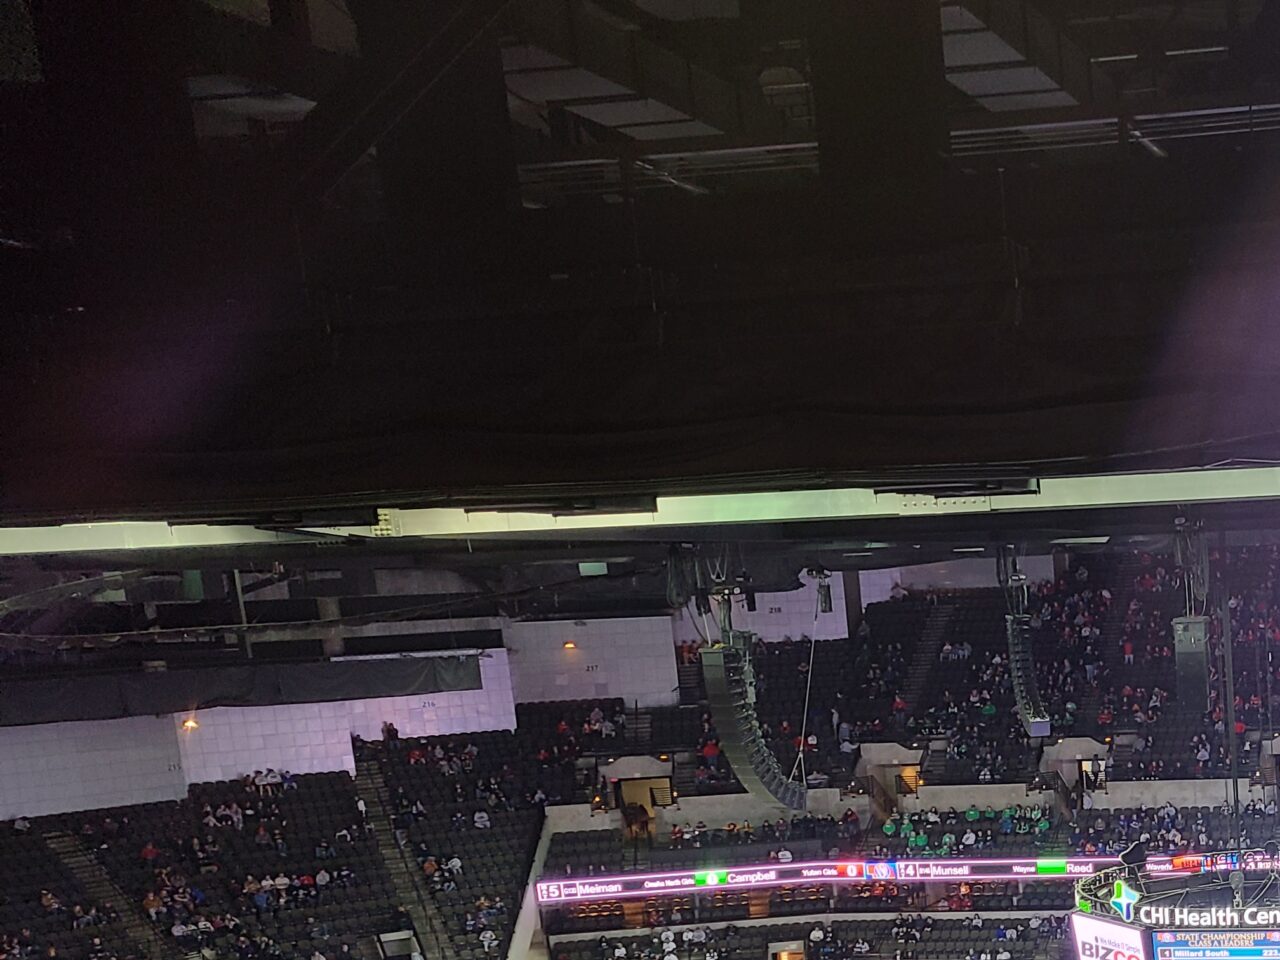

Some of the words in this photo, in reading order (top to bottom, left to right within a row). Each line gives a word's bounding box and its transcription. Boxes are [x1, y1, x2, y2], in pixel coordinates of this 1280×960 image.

[905, 864, 915, 877] 4
[932, 864, 969, 875] Munsell
[1012, 865, 1036, 874] Wayne
[1066, 863, 1093, 873] Reed
[548, 885, 559, 897] 5
[579, 883, 622, 895] Meiman
[727, 870, 776, 884] Campbell
[801, 868, 820, 877] Yutan
[1140, 906, 1170, 925] CHI
[1174, 906, 1239, 927] Health
[1176, 933, 1198, 941] STATE
[1200, 932, 1266, 941] CHAMPIONSHIP
